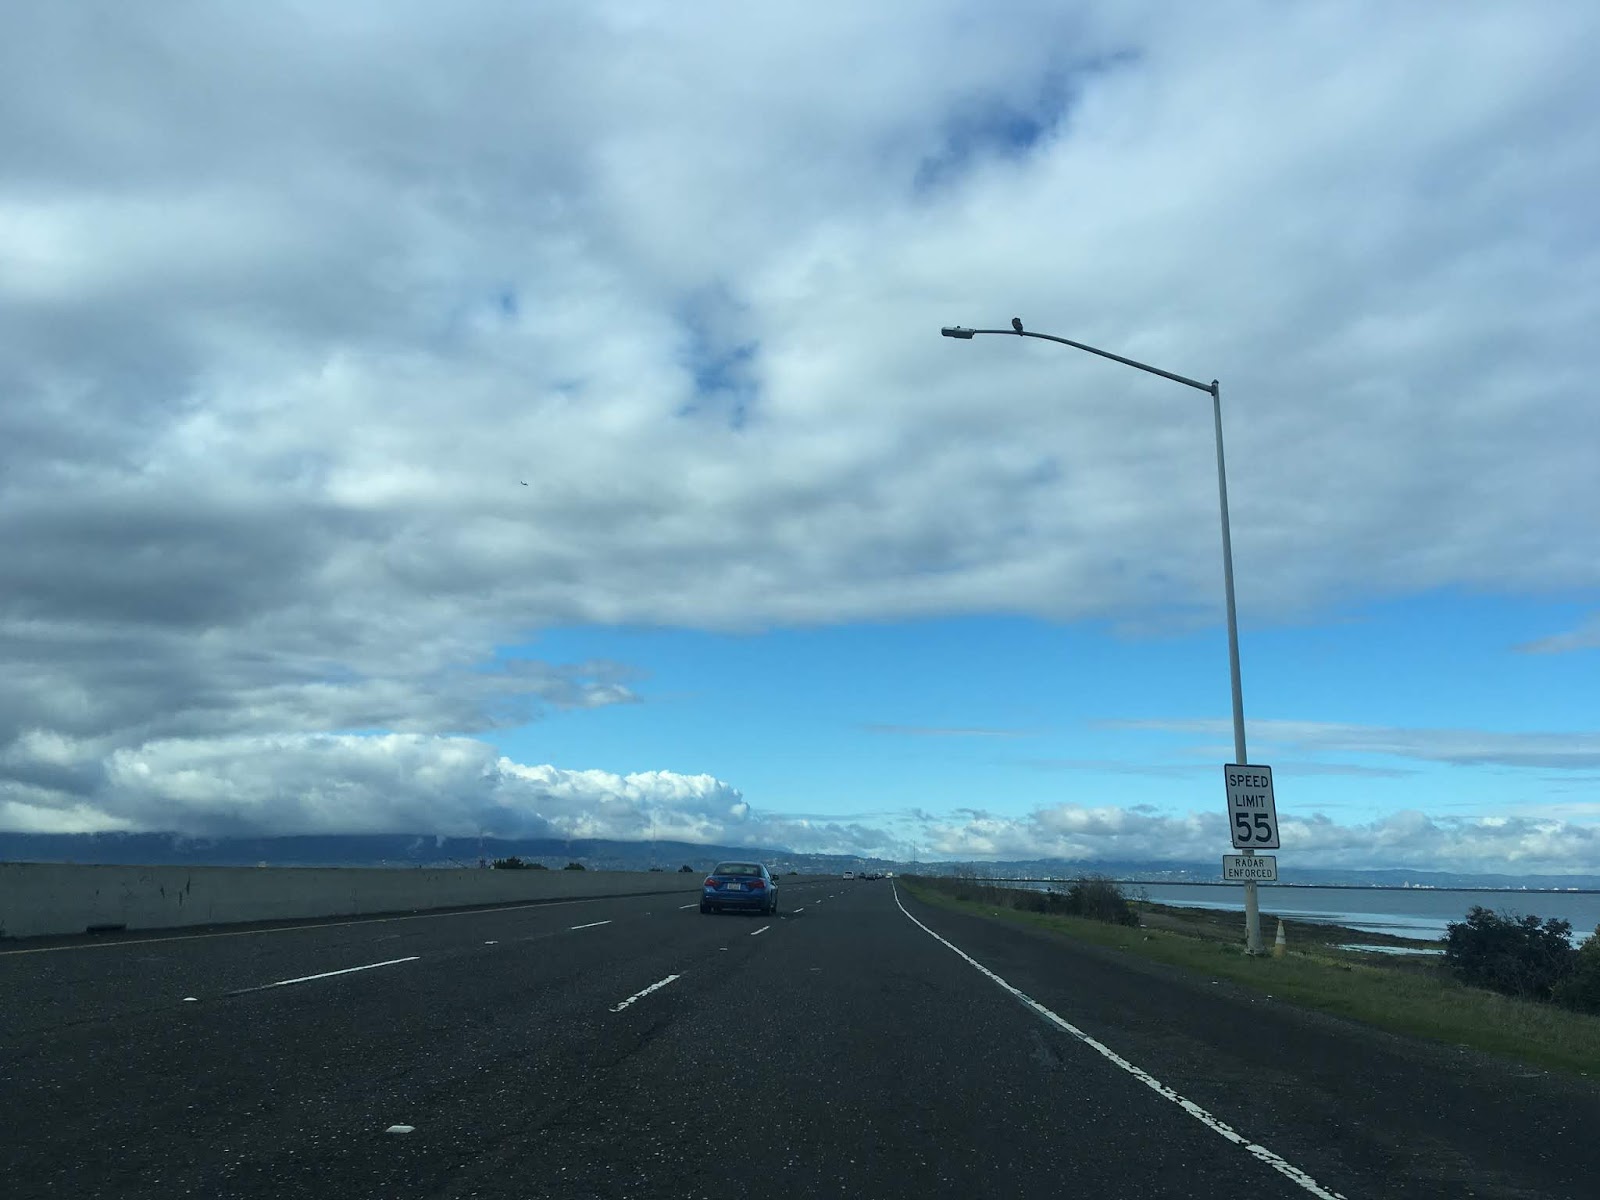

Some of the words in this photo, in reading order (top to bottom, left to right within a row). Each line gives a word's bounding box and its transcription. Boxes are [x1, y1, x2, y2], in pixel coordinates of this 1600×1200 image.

[1229, 774, 1269, 788] SPEED
[1235, 795, 1265, 808] LIMIT
[1235, 812, 1272, 843] 55
[1235, 858, 1265, 867] RADAR
[1228, 868, 1272, 878] ENFORCED
